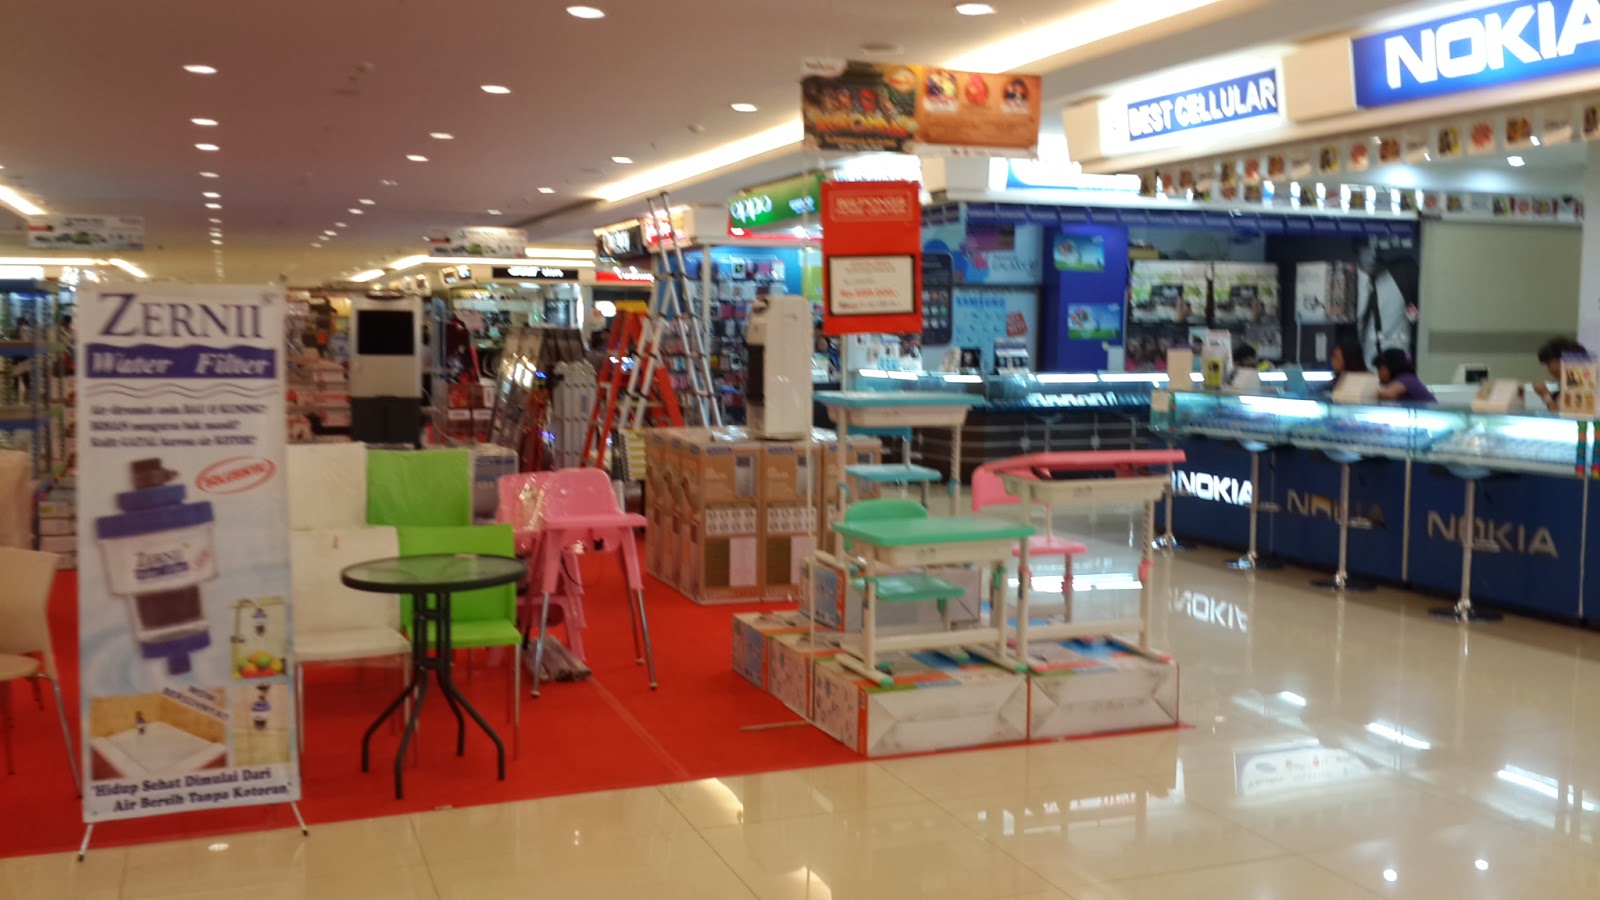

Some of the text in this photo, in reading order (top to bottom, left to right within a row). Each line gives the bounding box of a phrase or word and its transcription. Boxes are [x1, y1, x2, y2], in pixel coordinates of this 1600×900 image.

[1384, 0, 1600, 90] NOKIA
[1128, 77, 1276, 137] BEST CELLULAR
[99, 293, 263, 338] ZERNII
[91, 352, 270, 375] Water Filter
[1176, 469, 1253, 506] NOKIA
[142, 779, 181, 792] Sehat
[185, 771, 238, 787] Dimulai
[242, 768, 271, 781] Dari
[113, 800, 137, 812] Air
[140, 794, 184, 808] Bersih
[187, 791, 229, 804] Tanpa
